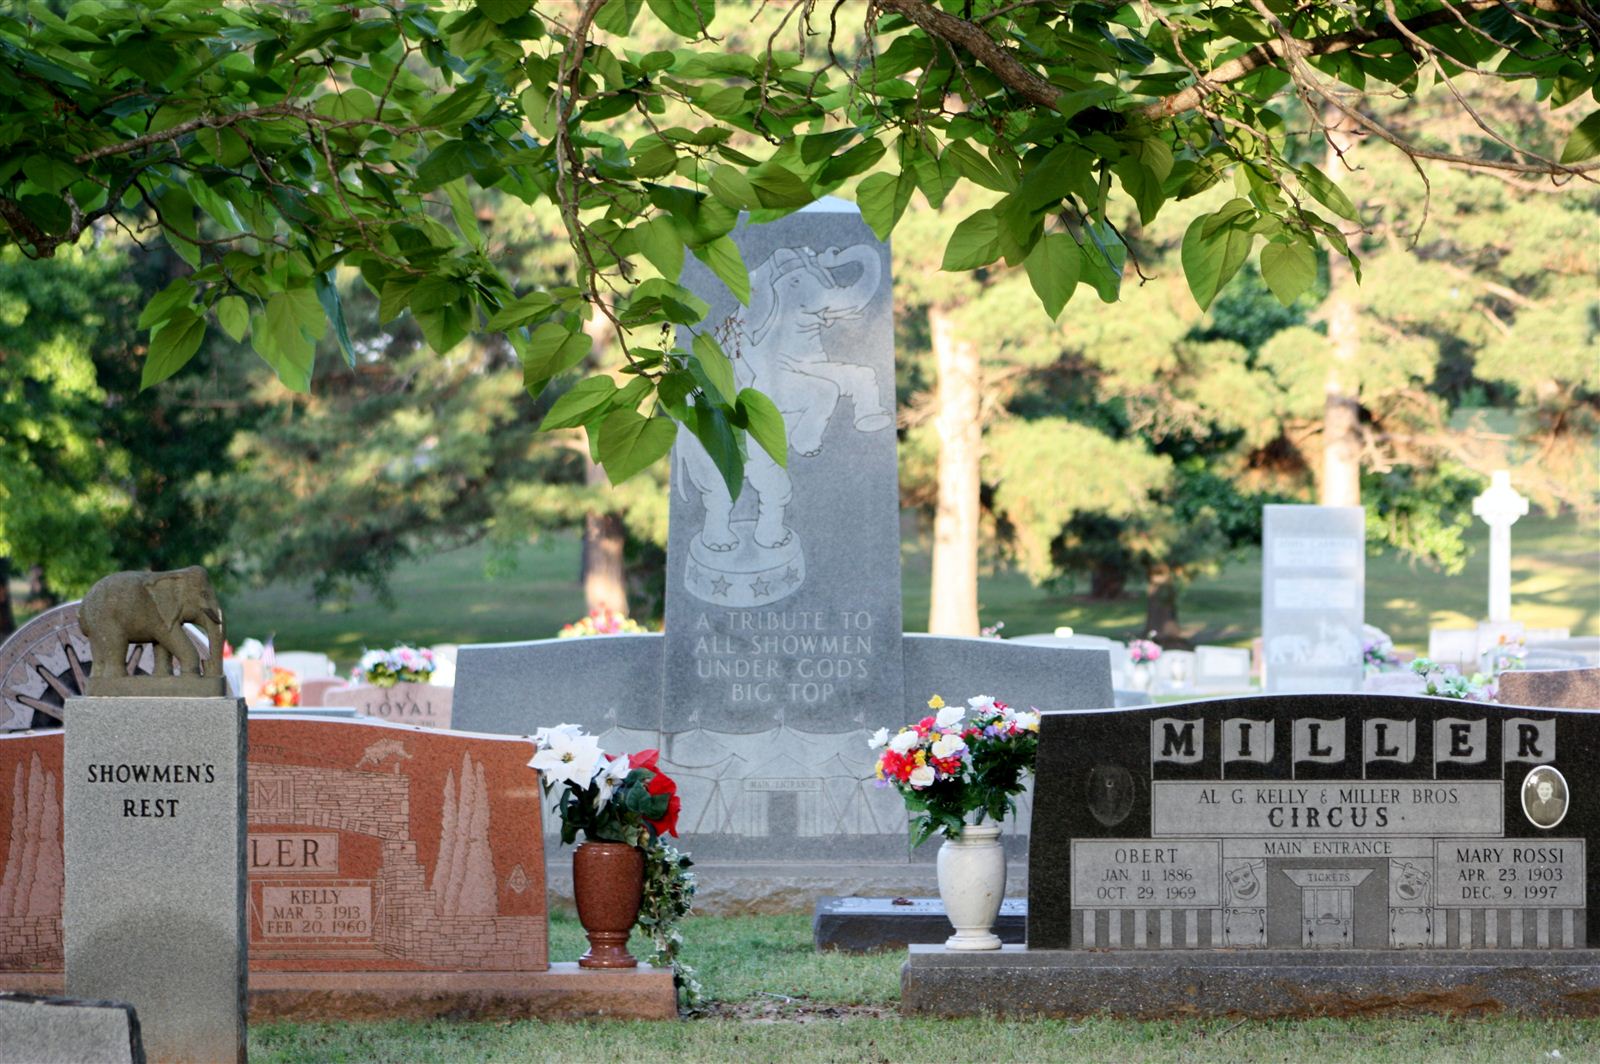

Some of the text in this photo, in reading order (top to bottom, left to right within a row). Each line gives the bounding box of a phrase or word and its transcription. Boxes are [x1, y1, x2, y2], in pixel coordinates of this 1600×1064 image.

[697, 610, 873, 631] A TRIBUTE TO
[694, 634, 873, 655] ALL SHOWMEN
[698, 657, 869, 679] UNDER GOD'S
[731, 682, 834, 703] BIG TOP
[366, 701, 436, 717] LOYAL
[1162, 723, 1544, 758] MILLER
[87, 763, 215, 784] SHOWMEN'S
[1198, 789, 1221, 804] AL
[1256, 789, 1309, 804] KELLY
[1320, 789, 1329, 805] &
[1339, 789, 1401, 804] MILLER
[123, 798, 180, 818] REST
[1268, 806, 1389, 828] CIRCUS
[1115, 848, 1179, 864] OBERT
[1264, 841, 1393, 855] MAIN ENTRANCE
[1456, 847, 1564, 864] MARY ROSSI
[1163, 868, 1193, 882] 1886
[1307, 872, 1351, 882] TICKETS
[1528, 867, 1564, 882] 1903
[290, 889, 341, 905] KELLY
[1166, 886, 1197, 900] 1969
[1523, 885, 1558, 900] 1997
[333, 906, 361, 919] 1913
[332, 920, 367, 934] 1960
